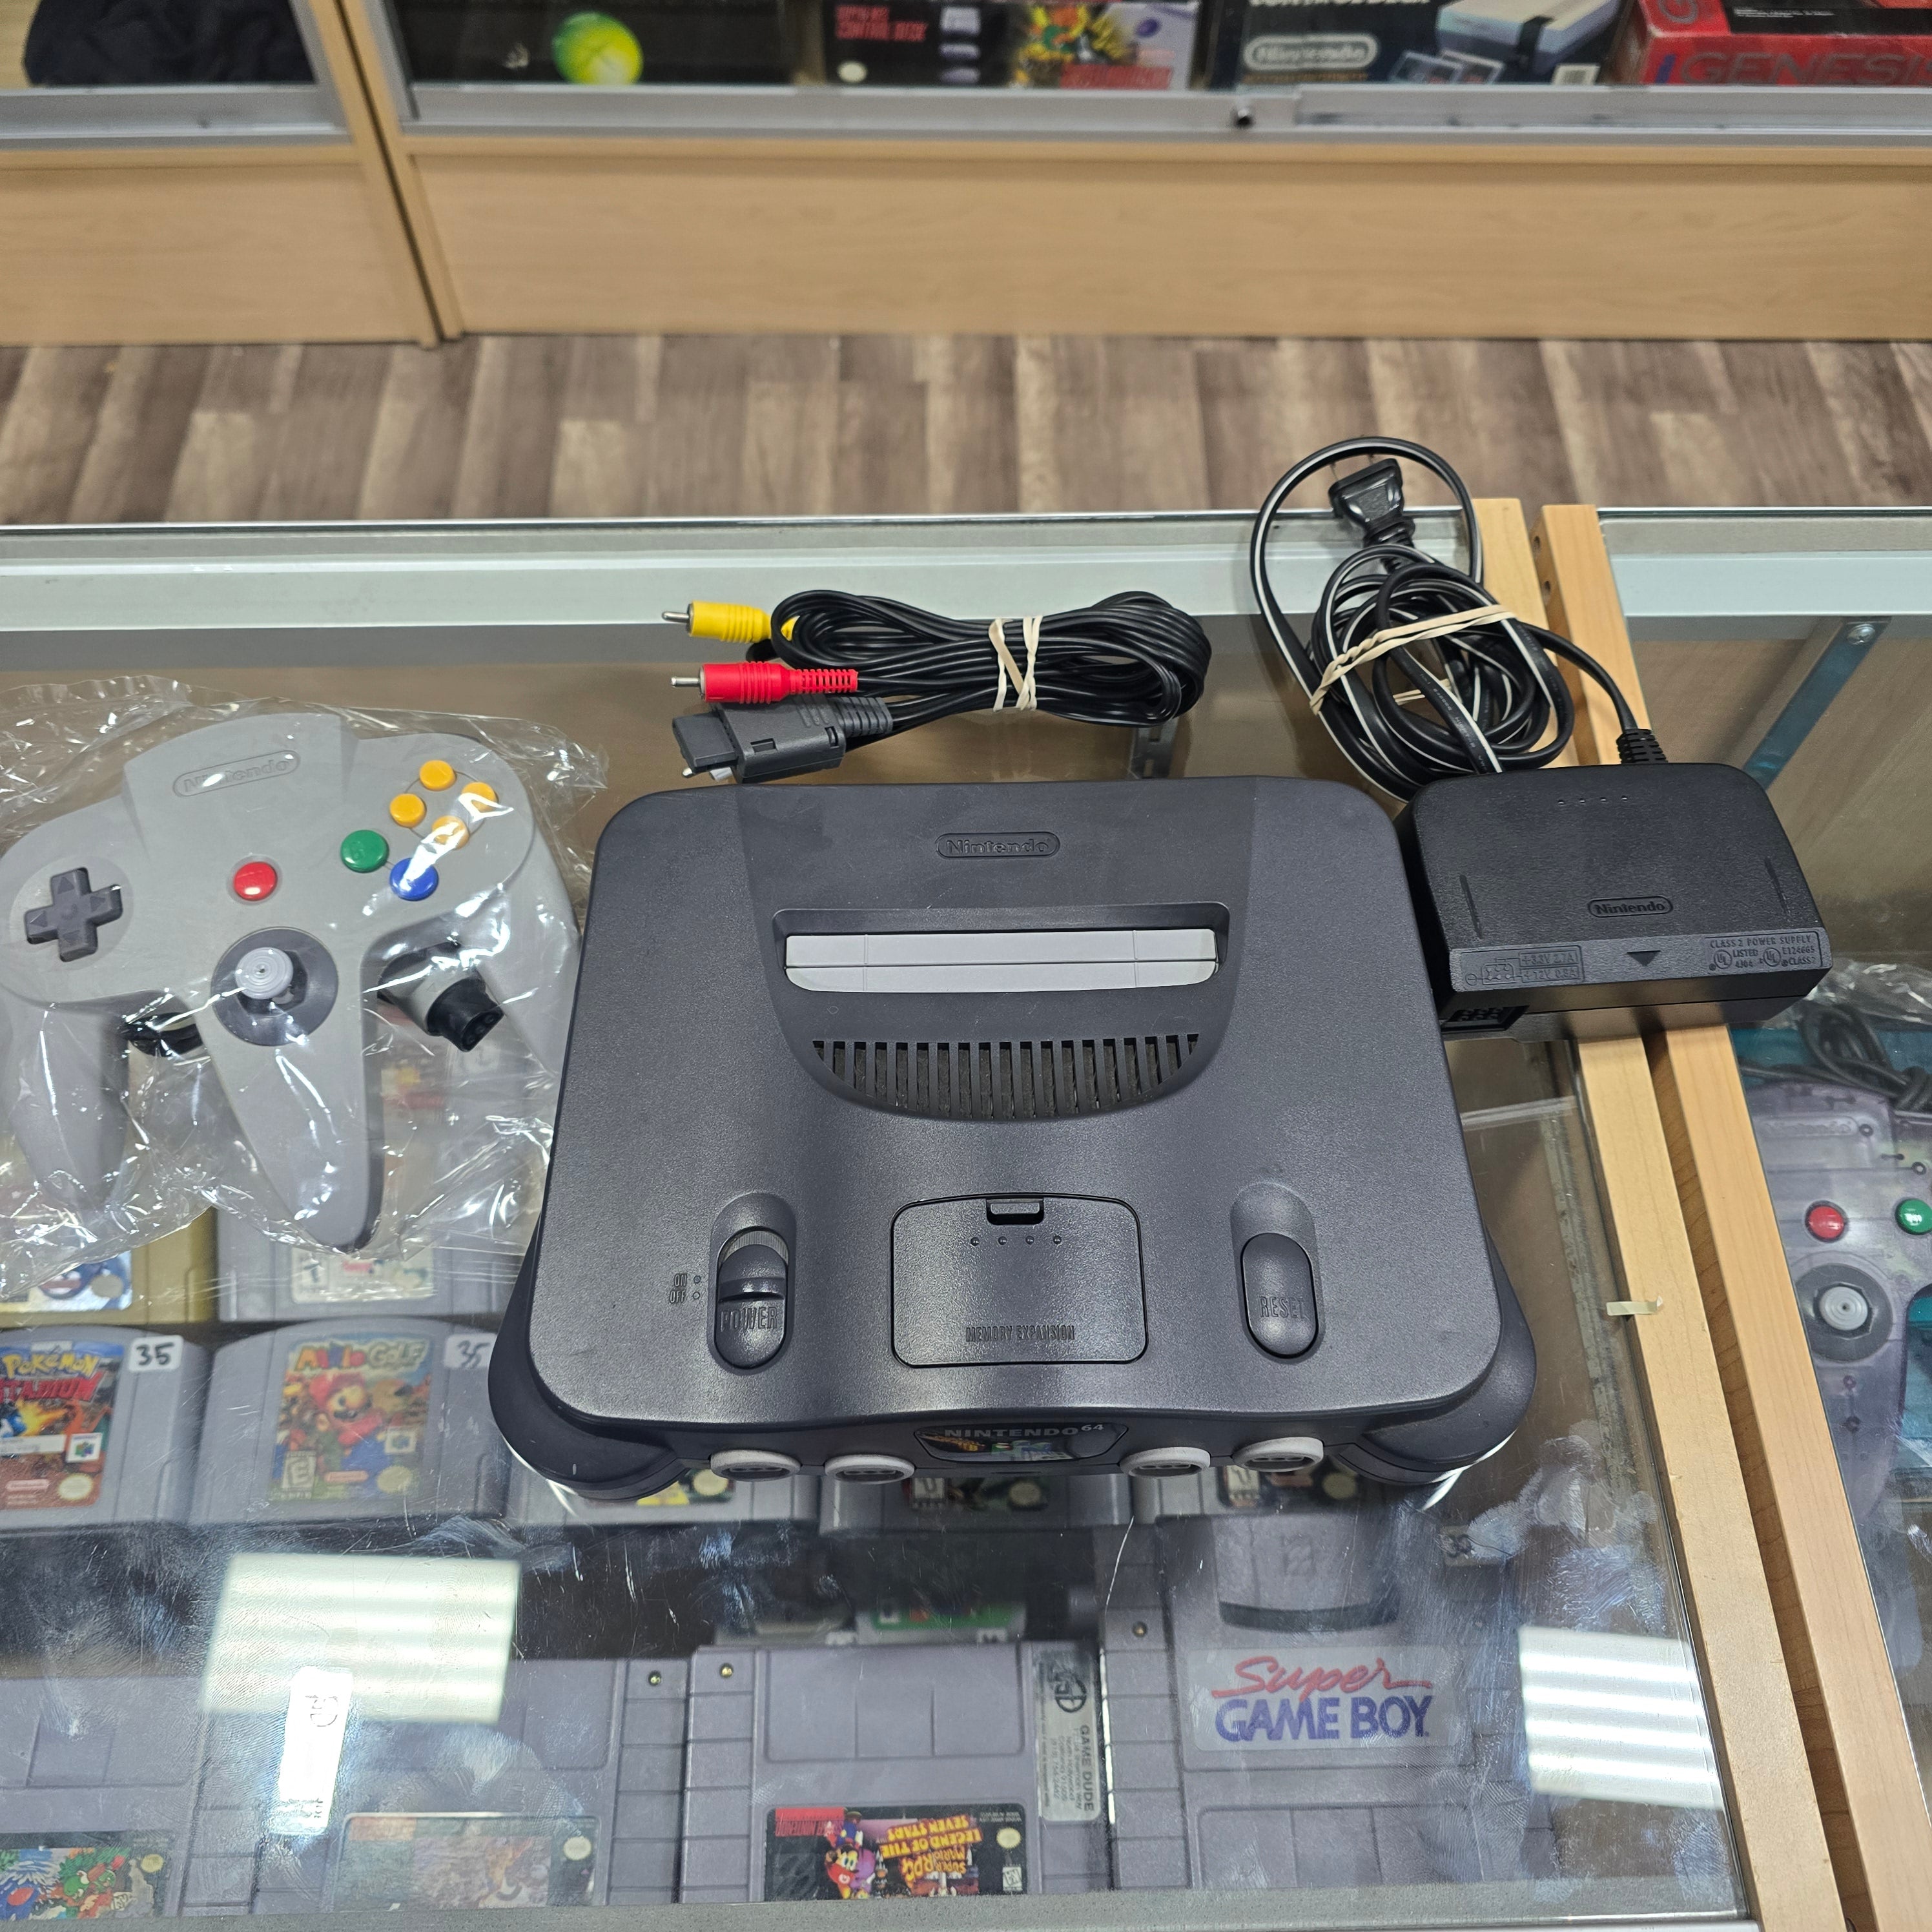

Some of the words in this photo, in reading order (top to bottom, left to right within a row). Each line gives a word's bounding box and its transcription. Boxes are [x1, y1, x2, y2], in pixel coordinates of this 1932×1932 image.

[184, 759, 290, 792] Ntendo
[946, 838, 1049, 854] Nintendo
[1594, 901, 1665, 914] Nintendo
[1747, 937, 1777, 947] POWER
[1780, 935, 1811, 944] SUPPLY
[673, 1273, 688, 1288] ON
[669, 1290, 686, 1304] OFF
[1259, 1295, 1306, 1319] RESET
[720, 1306, 778, 1333] POWER
[966, 1326, 1013, 1342] MEMORY
[1016, 1325, 1075, 1341] EXPANSION
[136, 1342, 175, 1367] 35
[365, 1340, 427, 1370] GOLF
[457, 1339, 491, 1369] 35
[945, 1427, 1078, 1437] NINTENDO
[1211, 1656, 1432, 1703] Super
[1215, 1696, 1341, 1742] GAME
[1350, 1695, 1435, 1739] BOY
[1080, 1724, 1092, 1767] GAME
[1082, 1771, 1094, 1812] DUDE
[887, 1822, 927, 1842] STARS
[928, 1814, 969, 1834] SEVEN
[912, 1838, 929, 1853] OF
[930, 1829, 981, 1849] LEGEND
[879, 1841, 910, 1859] THE
[933, 1846, 965, 1861] MARIO
[901, 1853, 934, 1882] RPG
[935, 1861, 966, 1874] SUPER
